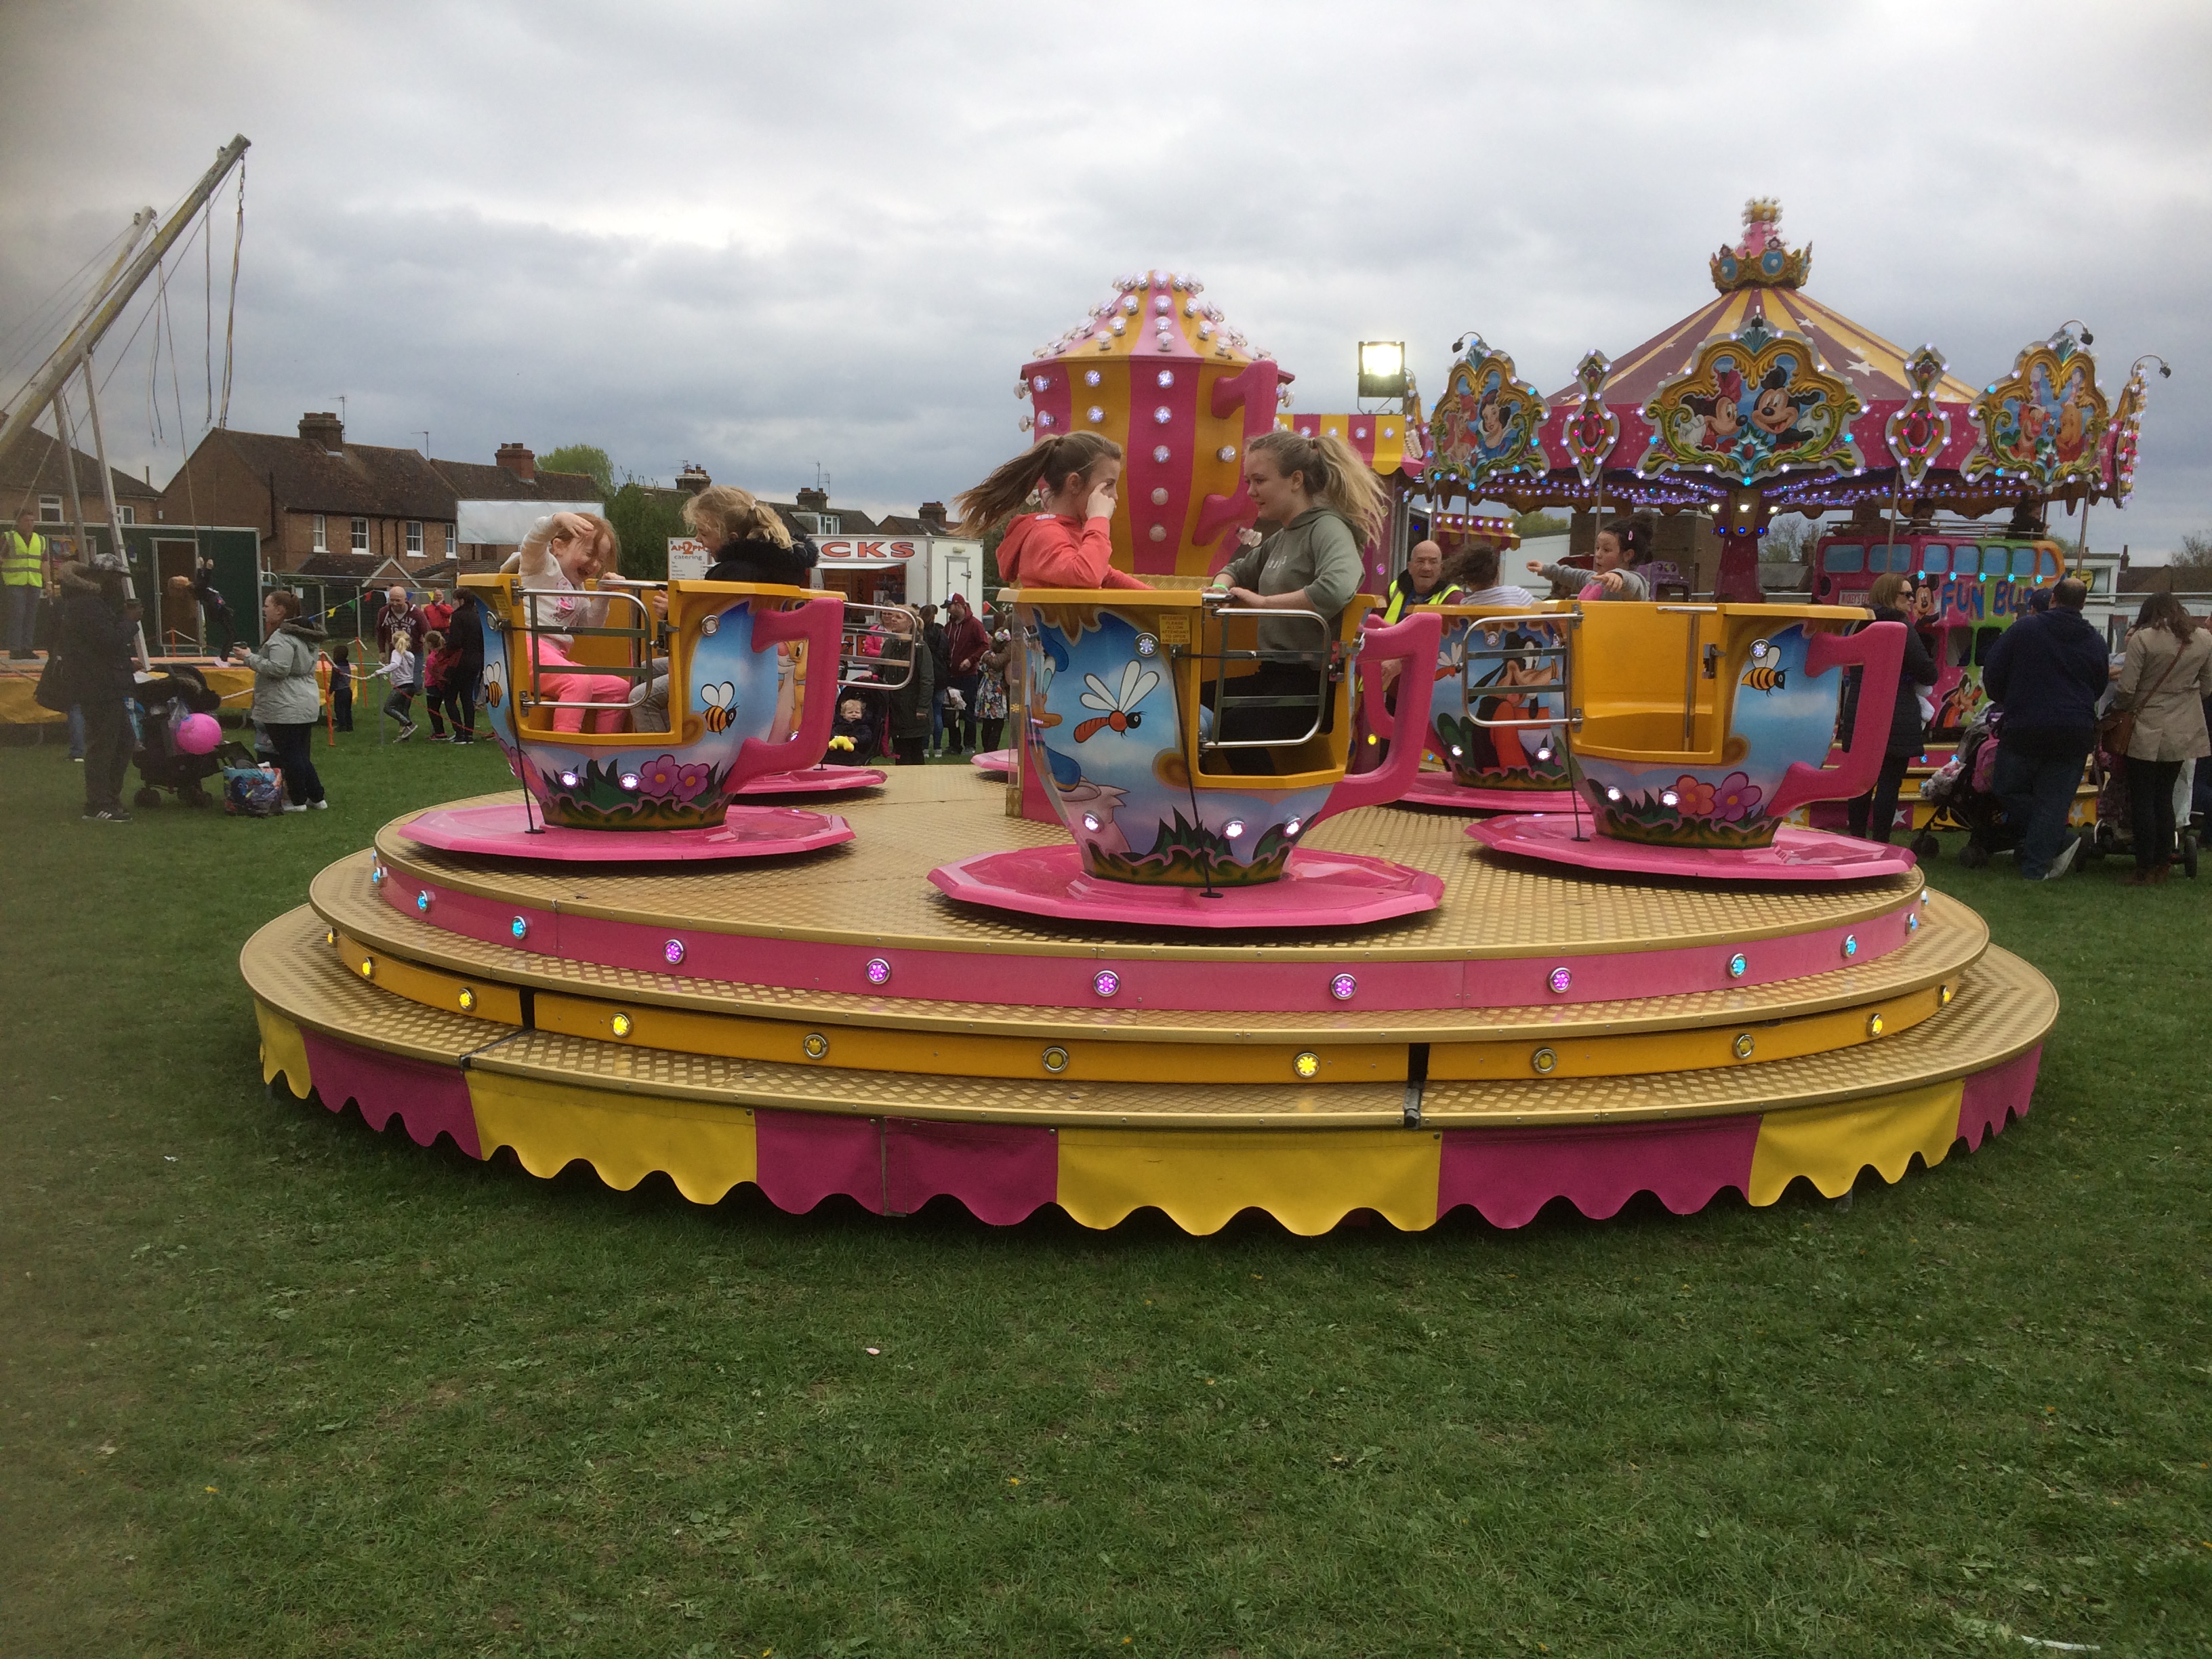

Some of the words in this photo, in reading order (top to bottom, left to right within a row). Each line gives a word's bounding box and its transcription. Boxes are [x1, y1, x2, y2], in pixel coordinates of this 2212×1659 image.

[671, 541, 705, 554] AM2PM
[821, 541, 916, 558] CKS
[1941, 581, 1986, 621] FUN
